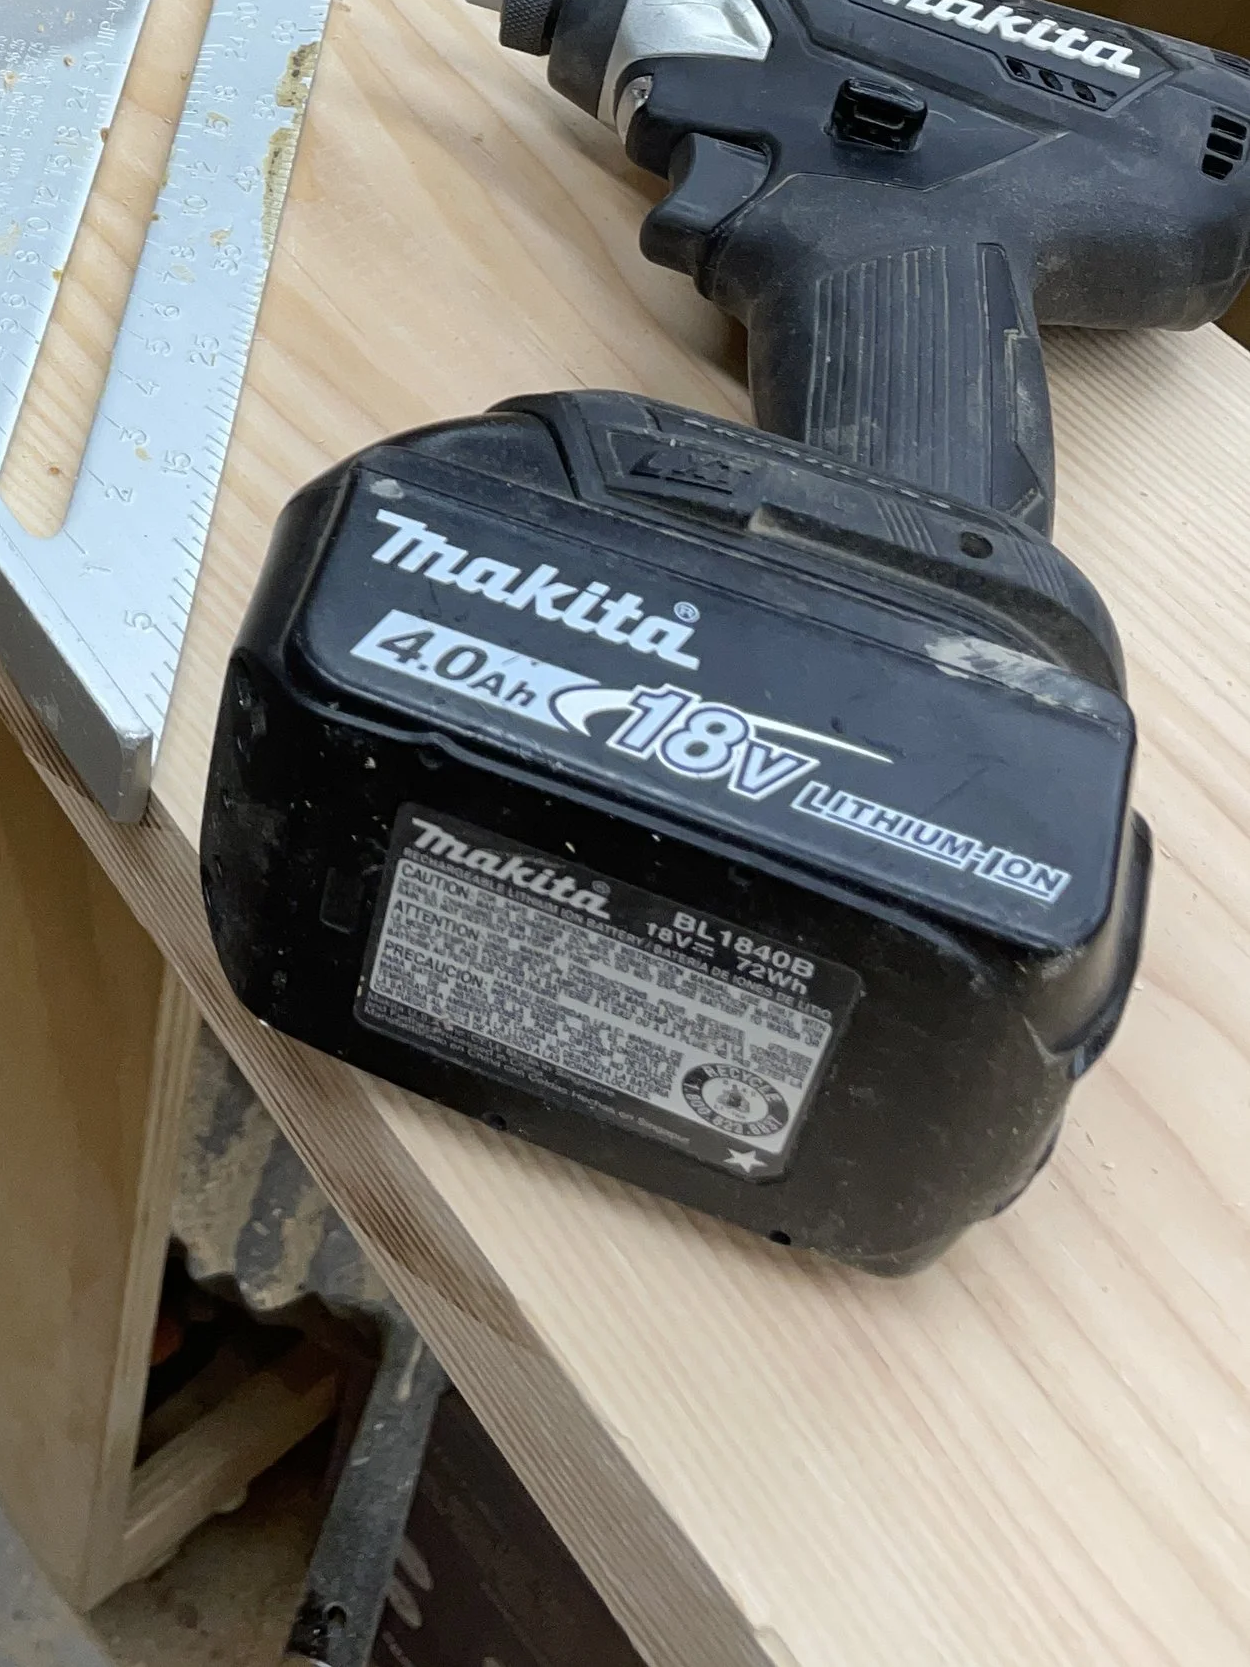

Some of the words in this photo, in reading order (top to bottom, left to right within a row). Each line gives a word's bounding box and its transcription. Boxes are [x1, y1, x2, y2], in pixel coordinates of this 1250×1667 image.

[188, 334, 220, 367] 25
[159, 449, 192, 475] 15
[104, 484, 134, 503] 2
[124, 609, 153, 631] 5
[375, 629, 537, 712] 4.0Ah
[606, 681, 820, 803] 18V
[791, 778, 1072, 904] LITHIUM-ION
[402, 845, 505, 894] RECHARGEABLE
[584, 917, 643, 948] BATTERY
[709, 965, 730, 981] DE
[643, 920, 693, 951] 18V
[735, 956, 811, 996] 72Wh
[672, 910, 817, 981] BL1840B
[698, 1055, 787, 1105] RECYCLE
